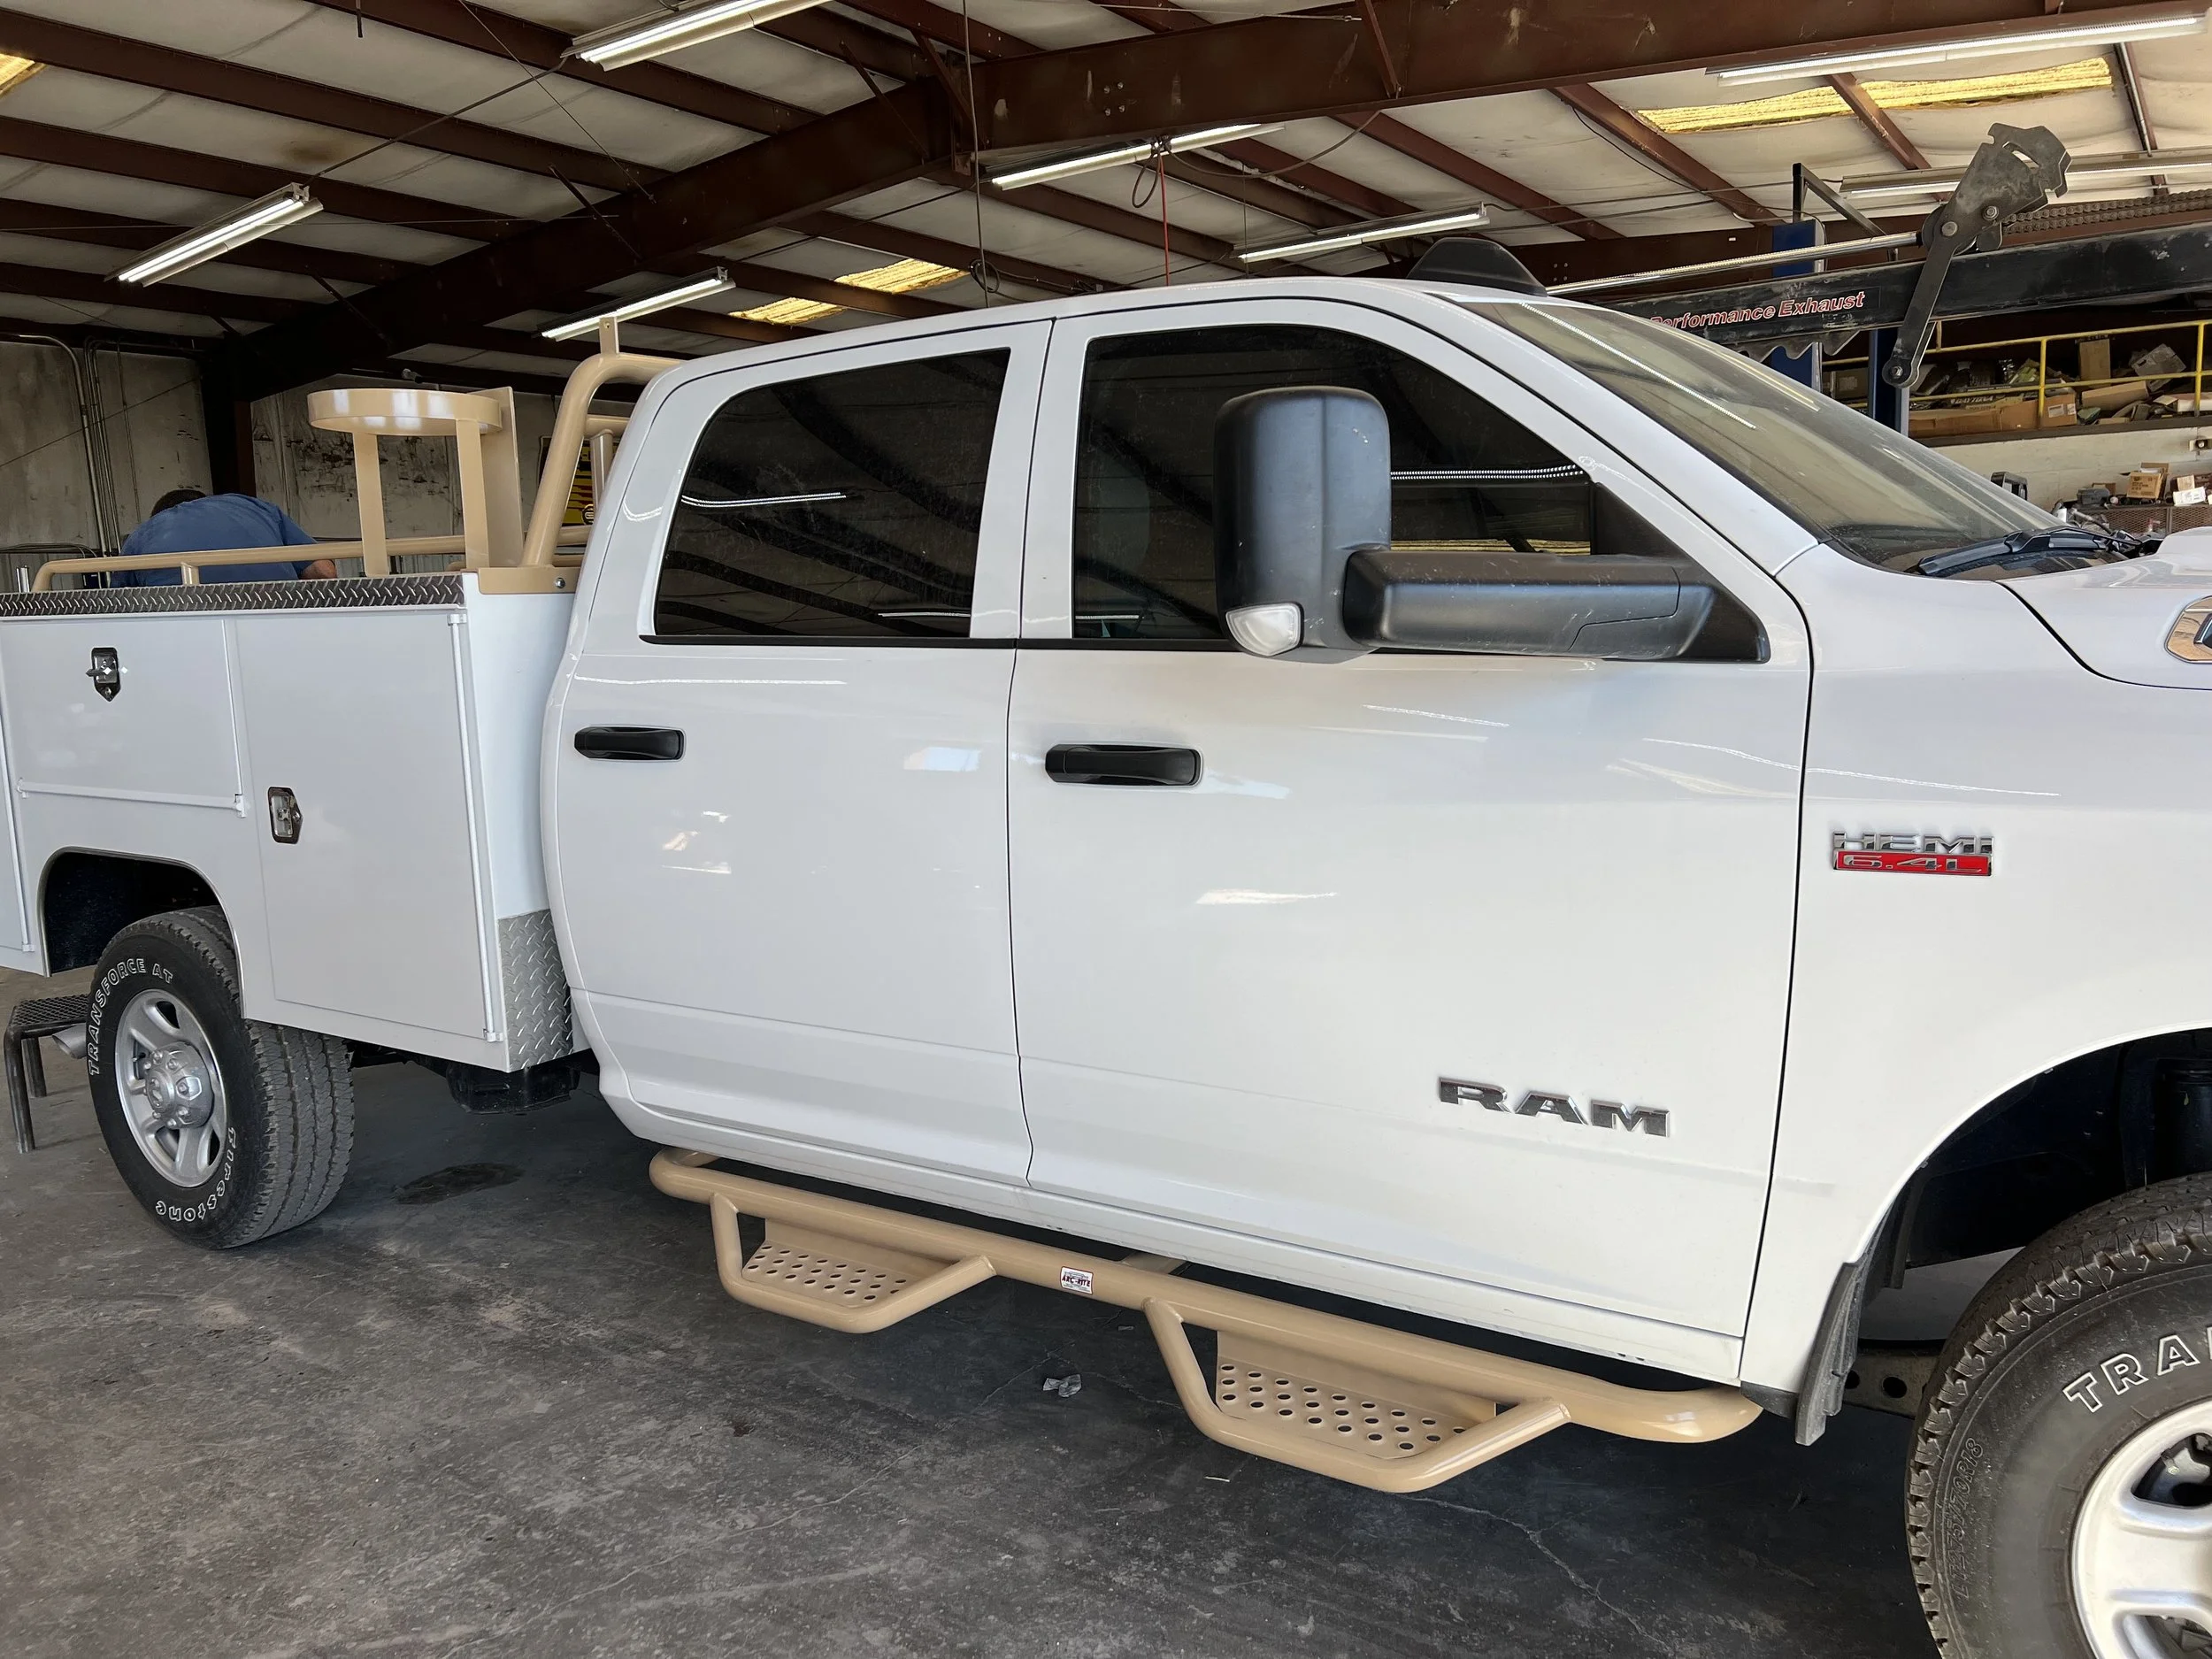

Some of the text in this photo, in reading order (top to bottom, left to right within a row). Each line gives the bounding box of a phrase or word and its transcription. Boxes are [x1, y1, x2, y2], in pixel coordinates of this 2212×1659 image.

[1778, 291, 1865, 318] Exhaust
[1833, 831, 1994, 856] HEMI
[1843, 854, 1982, 873] 6.4L
[88, 958, 173, 1075] TRANSFORCE AT
[1439, 1077, 1671, 1137] RAM
[2062, 1325, 2212, 1413] TRA
